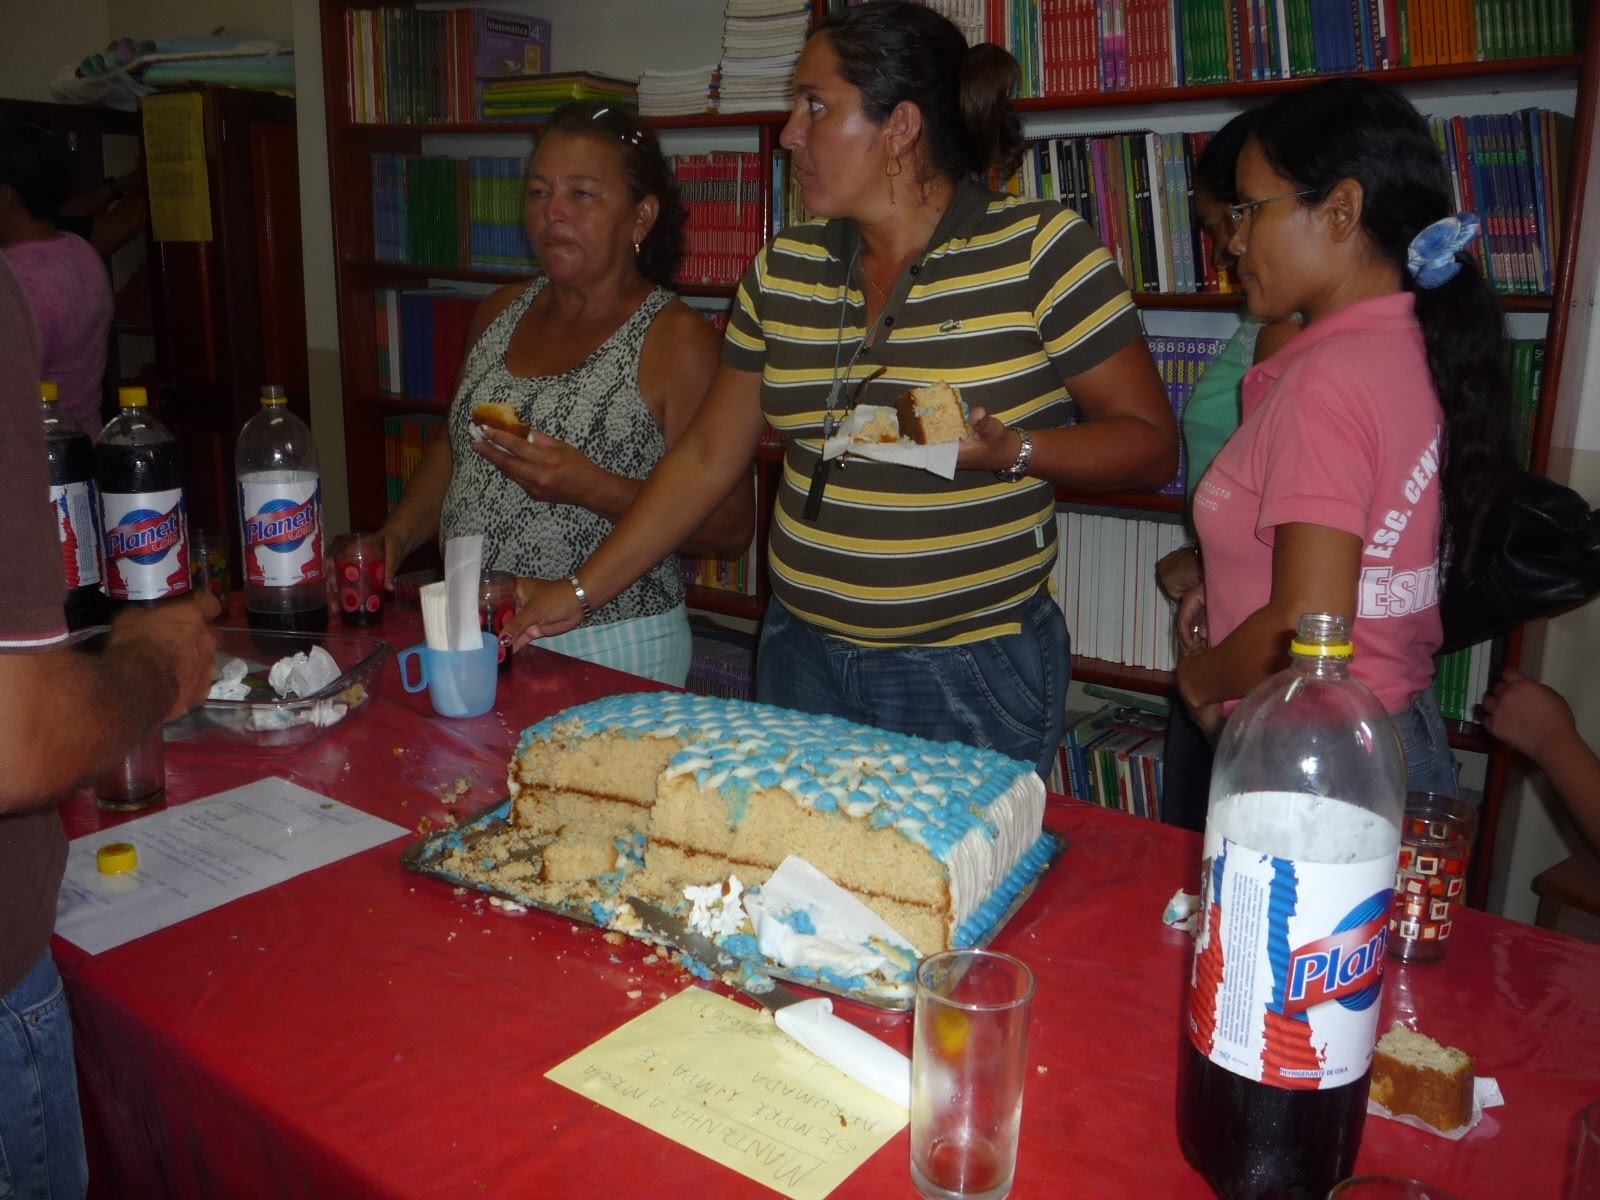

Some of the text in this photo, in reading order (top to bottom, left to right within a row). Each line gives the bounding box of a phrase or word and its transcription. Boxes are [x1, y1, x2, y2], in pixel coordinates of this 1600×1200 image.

[486, 19, 529, 36] Matemática
[1232, 6, 1241, 69] GEOGRAFIA
[107, 513, 177, 557] Planet
[248, 504, 313, 544] Planet
[1364, 509, 1412, 559] ESC.
[1288, 924, 1387, 1001] Plan
[672, 1063, 741, 1104] LIMPA
[1280, 1066, 1348, 1078] REFRIGERANTE DE COLA
[649, 1095, 667, 1110] A
[751, 1071, 878, 1132] ARRUMADA
[671, 1105, 821, 1189] MANTENHA
[752, 1099, 858, 1155] SEMPRE
